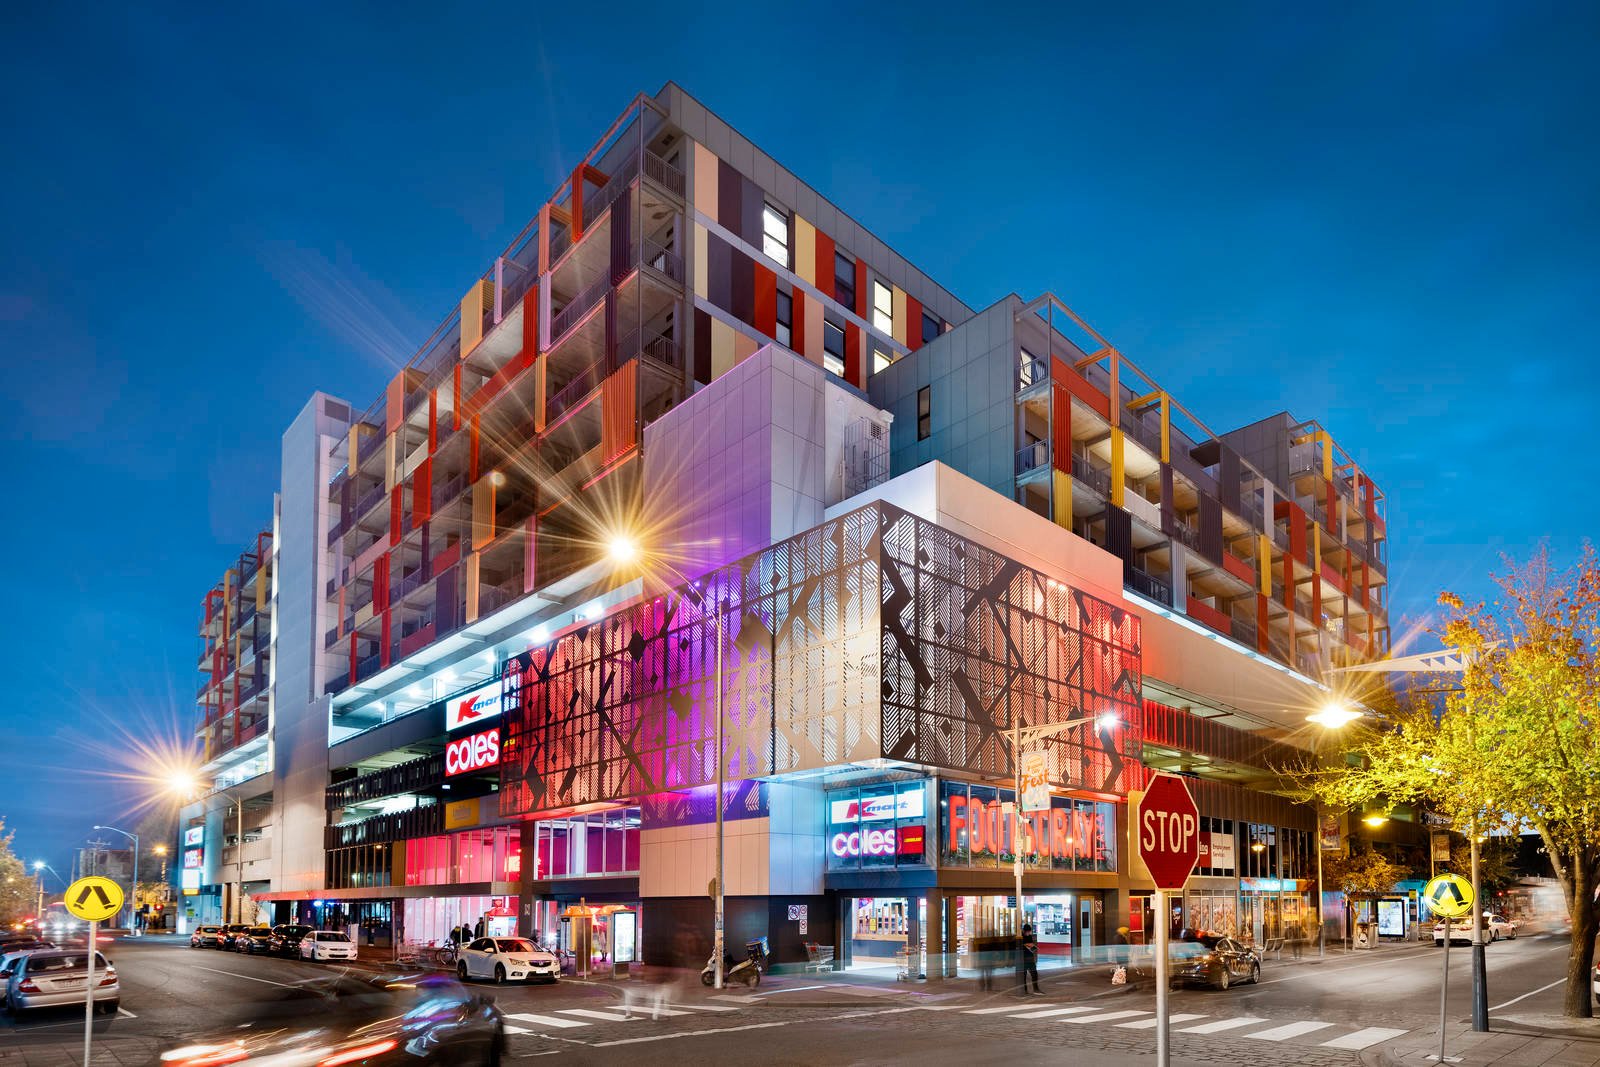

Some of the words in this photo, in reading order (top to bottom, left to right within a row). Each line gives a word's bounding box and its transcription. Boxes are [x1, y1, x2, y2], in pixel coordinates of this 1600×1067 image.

[457, 694, 501, 722] Kmar
[446, 731, 499, 774] coles
[1021, 768, 1049, 794] Fest
[846, 800, 909, 818] Kmart
[832, 829, 896, 857] coles
[1143, 809, 1195, 853] STOP
